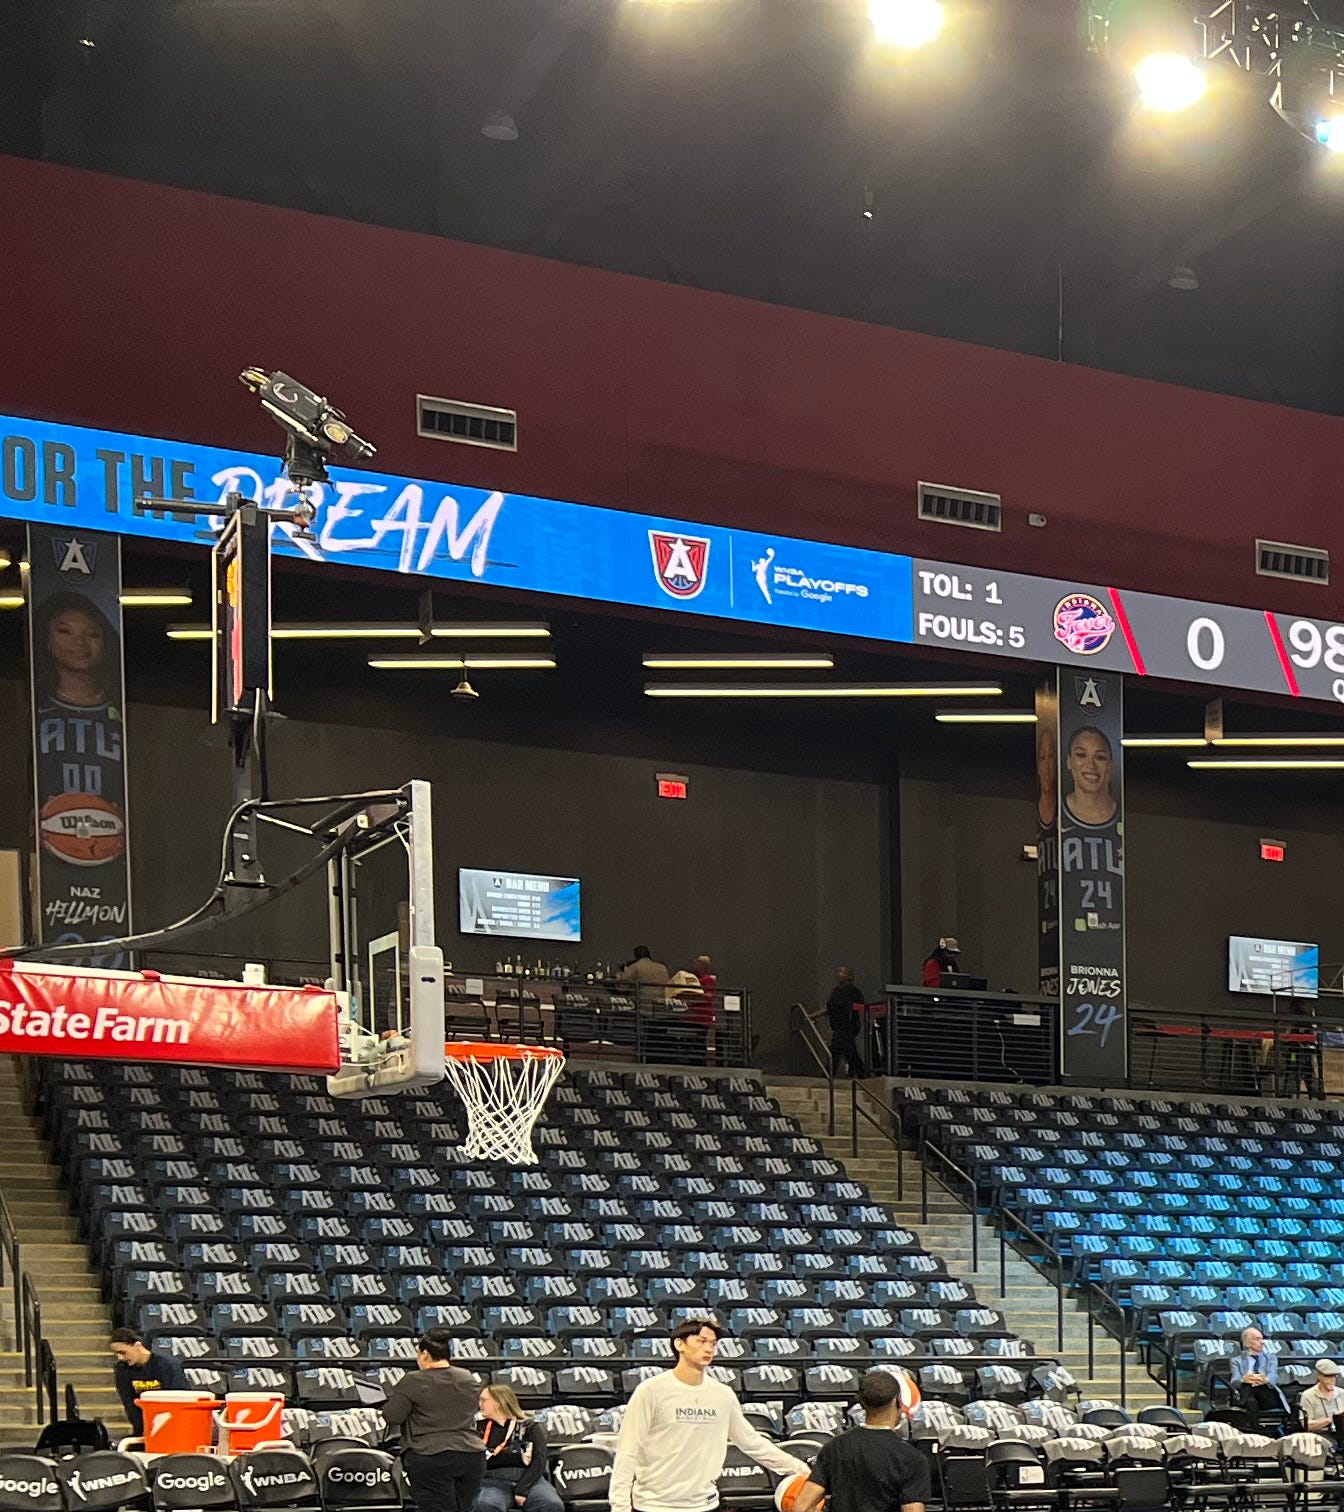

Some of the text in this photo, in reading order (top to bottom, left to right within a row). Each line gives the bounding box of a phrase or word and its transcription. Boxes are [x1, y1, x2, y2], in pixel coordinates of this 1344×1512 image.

[97, 449, 196, 523] THE
[774, 574, 869, 597] PLAYOFFS
[801, 589, 832, 602] Google
[919, 571, 1003, 604] TOL: 1
[919, 612, 1025, 648] FOULS: 5
[1187, 617, 1224, 671] 0
[1062, 837, 1123, 877] ATL
[70, 886, 101, 898] NAZ
[1080, 879, 1112, 909] 24
[45, 900, 127, 926] HILLMON
[1071, 965, 1119, 977] BRIONNA
[1066, 976, 1121, 998] JONES
[1067, 1003, 1123, 1048] 24
[675, 1407, 717, 1417] INDIANA
[82, 1470, 142, 1492] WNBA
[157, 1472, 226, 1493] Google
[253, 1470, 311, 1486] WNBA
[327, 1466, 392, 1486] Google
[563, 1465, 613, 1480] WNBA
